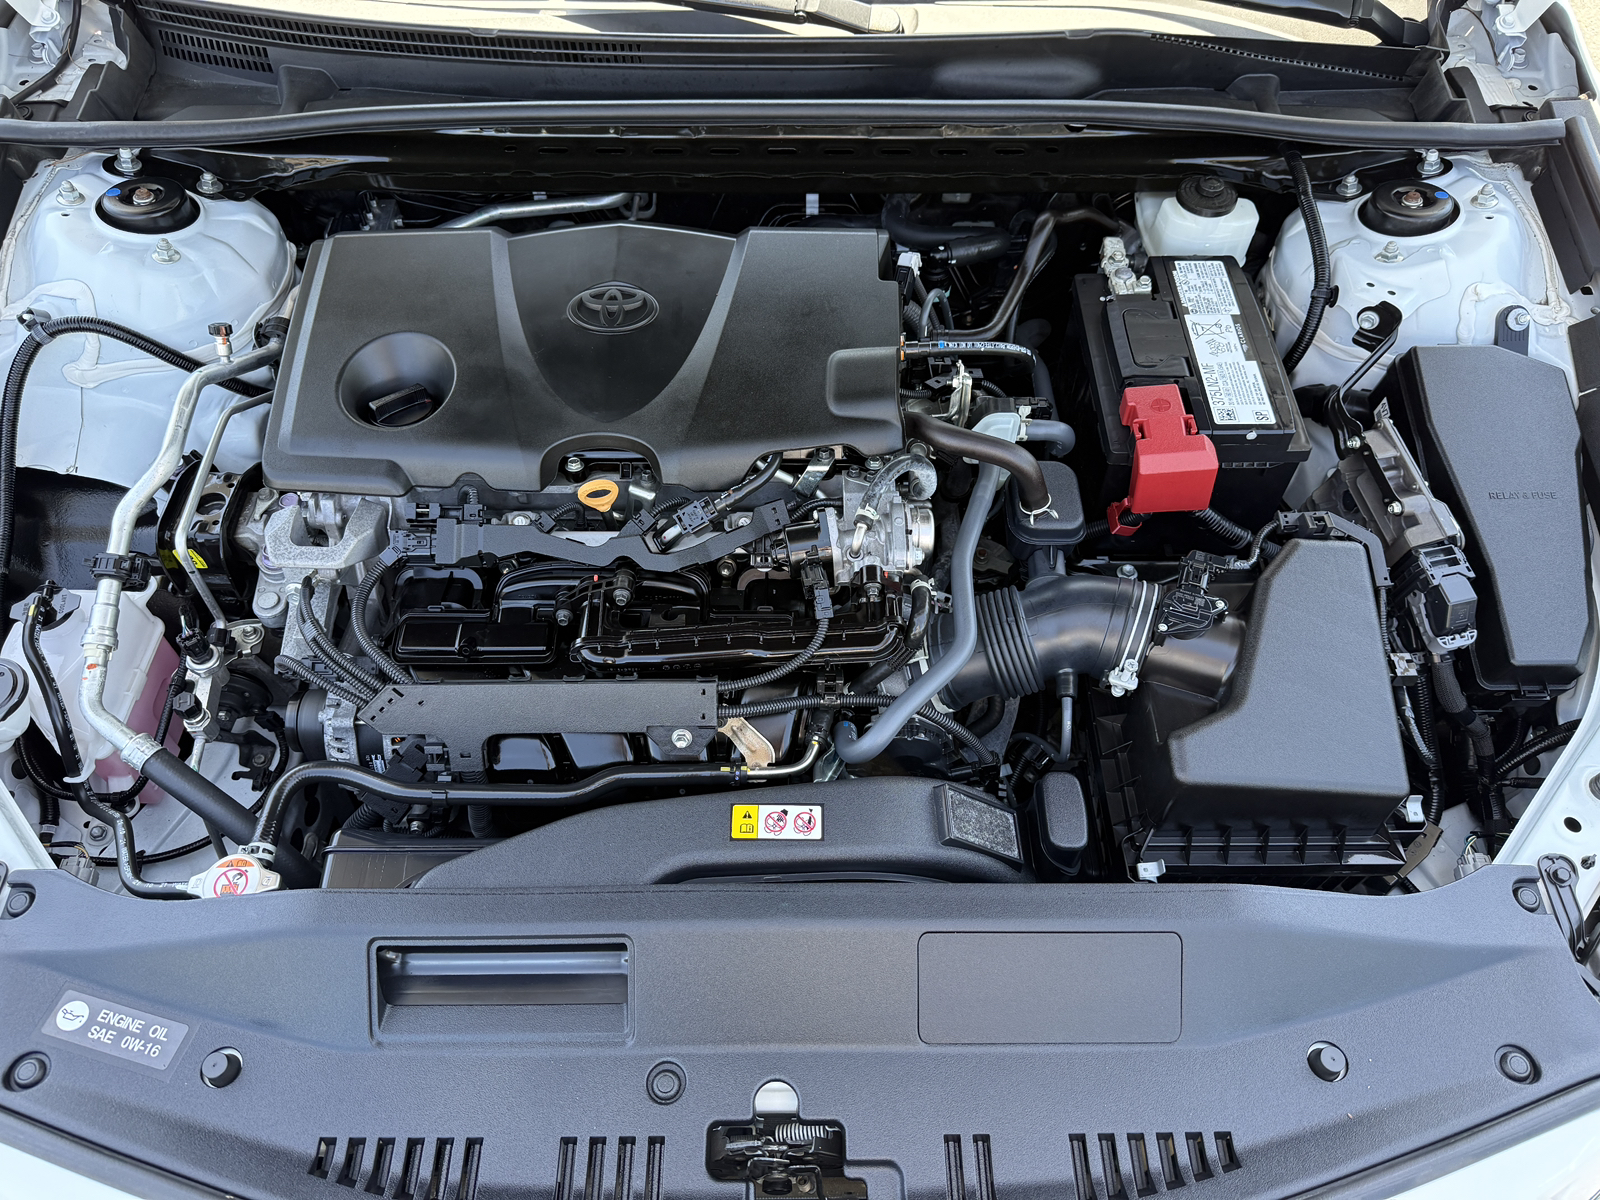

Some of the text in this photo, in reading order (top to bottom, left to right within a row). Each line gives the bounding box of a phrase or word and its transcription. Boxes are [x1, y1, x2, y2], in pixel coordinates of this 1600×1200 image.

[1235, 323, 1246, 344] CLARIOS
[1201, 362, 1225, 405] 375LN2-MF
[1255, 411, 1269, 421] SP
[1488, 491, 1558, 500] RELAY & FUSE
[97, 1009, 168, 1042] ENGINE OIL
[87, 1025, 162, 1058] SAE 0W-16
